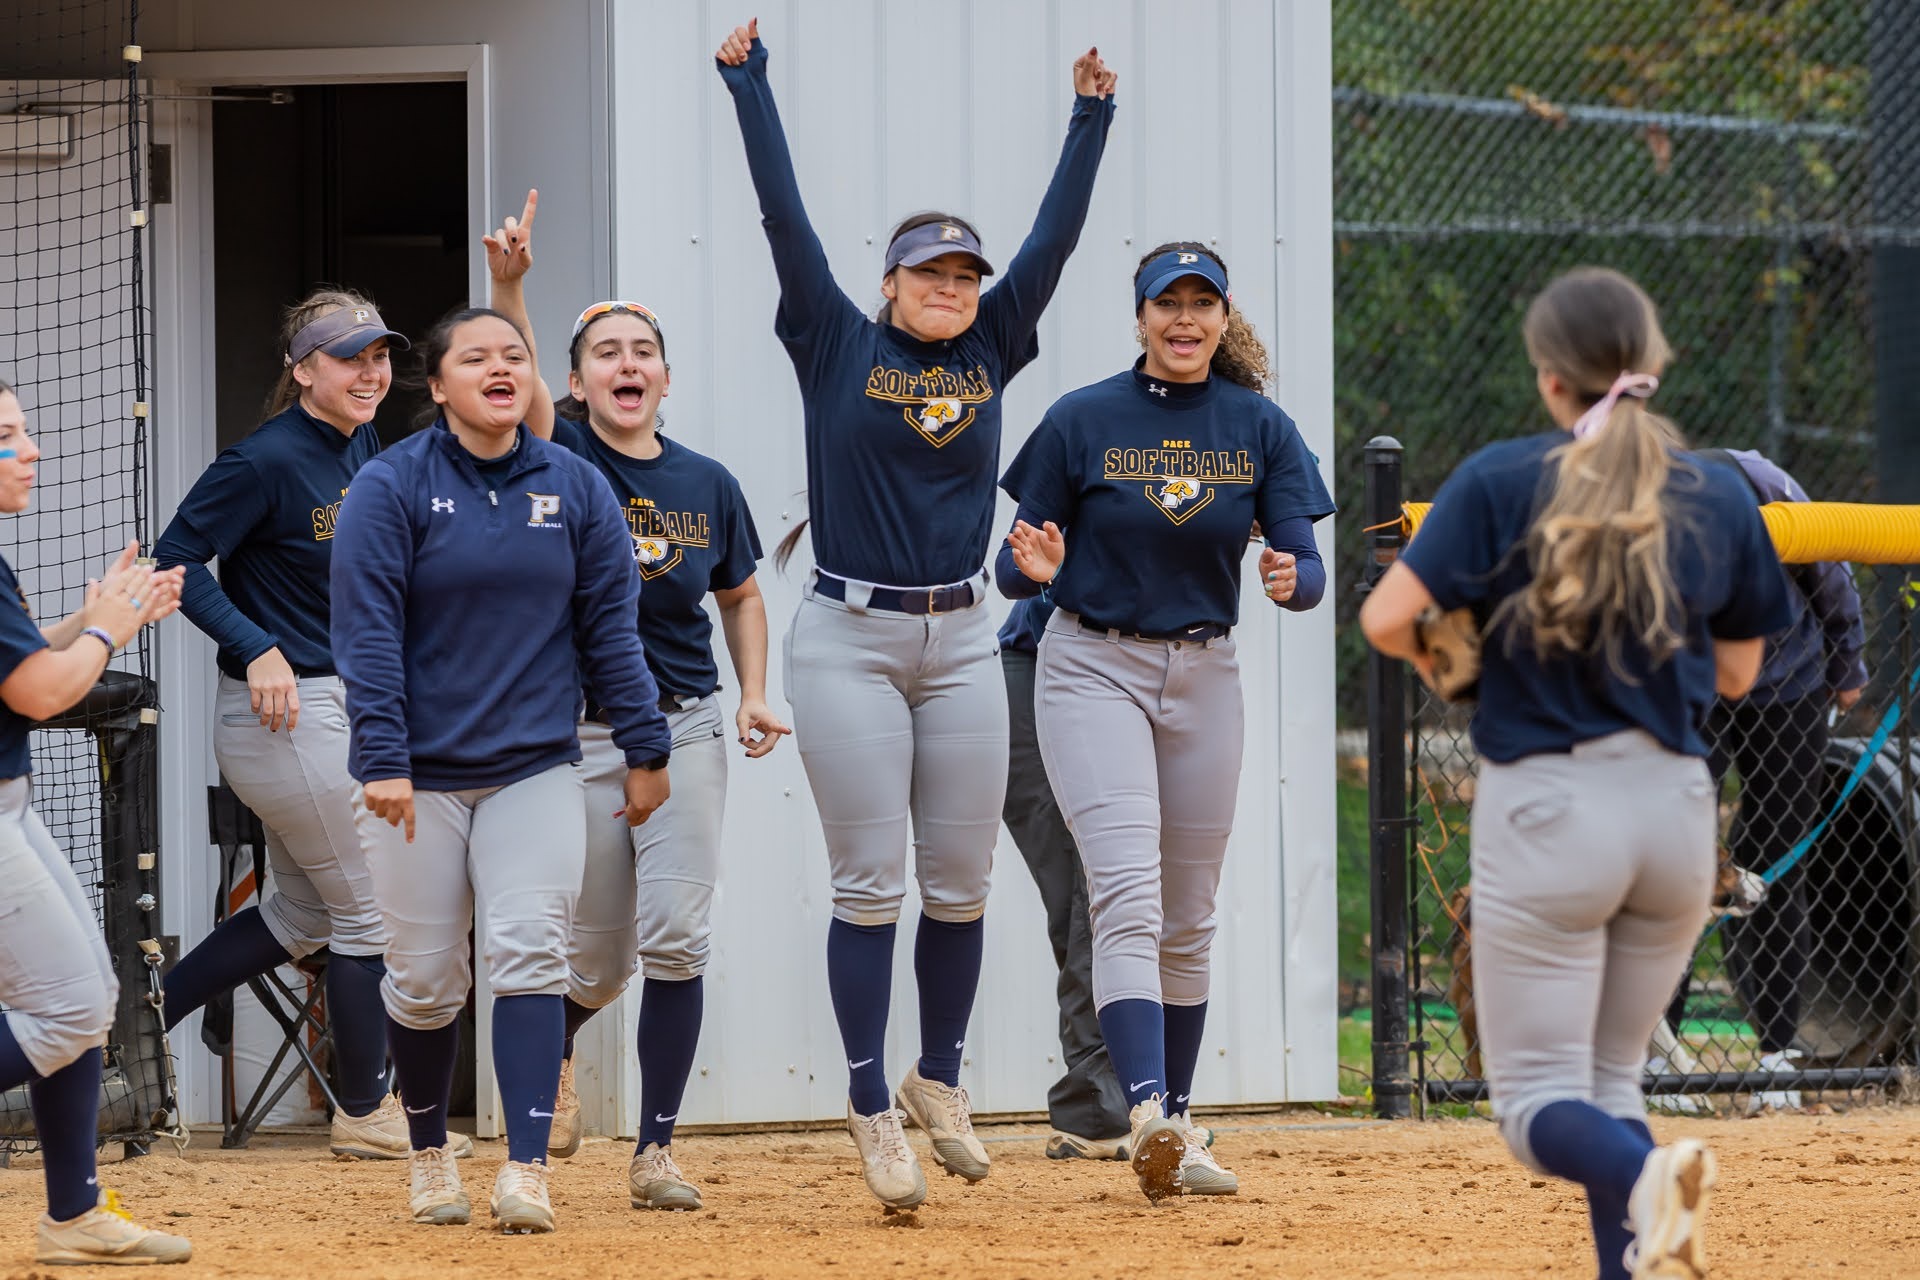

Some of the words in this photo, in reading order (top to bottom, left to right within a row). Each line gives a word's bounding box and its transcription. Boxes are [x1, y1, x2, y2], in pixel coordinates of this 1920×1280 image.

[940, 225, 962, 240] P
[1177, 252, 1198, 264] P
[352, 308, 370, 323] P
[1163, 440, 1191, 448] PACE
[1104, 448, 1254, 477] SOFTBALL
[526, 492, 560, 522] P
[620, 507, 710, 541] TBALL
